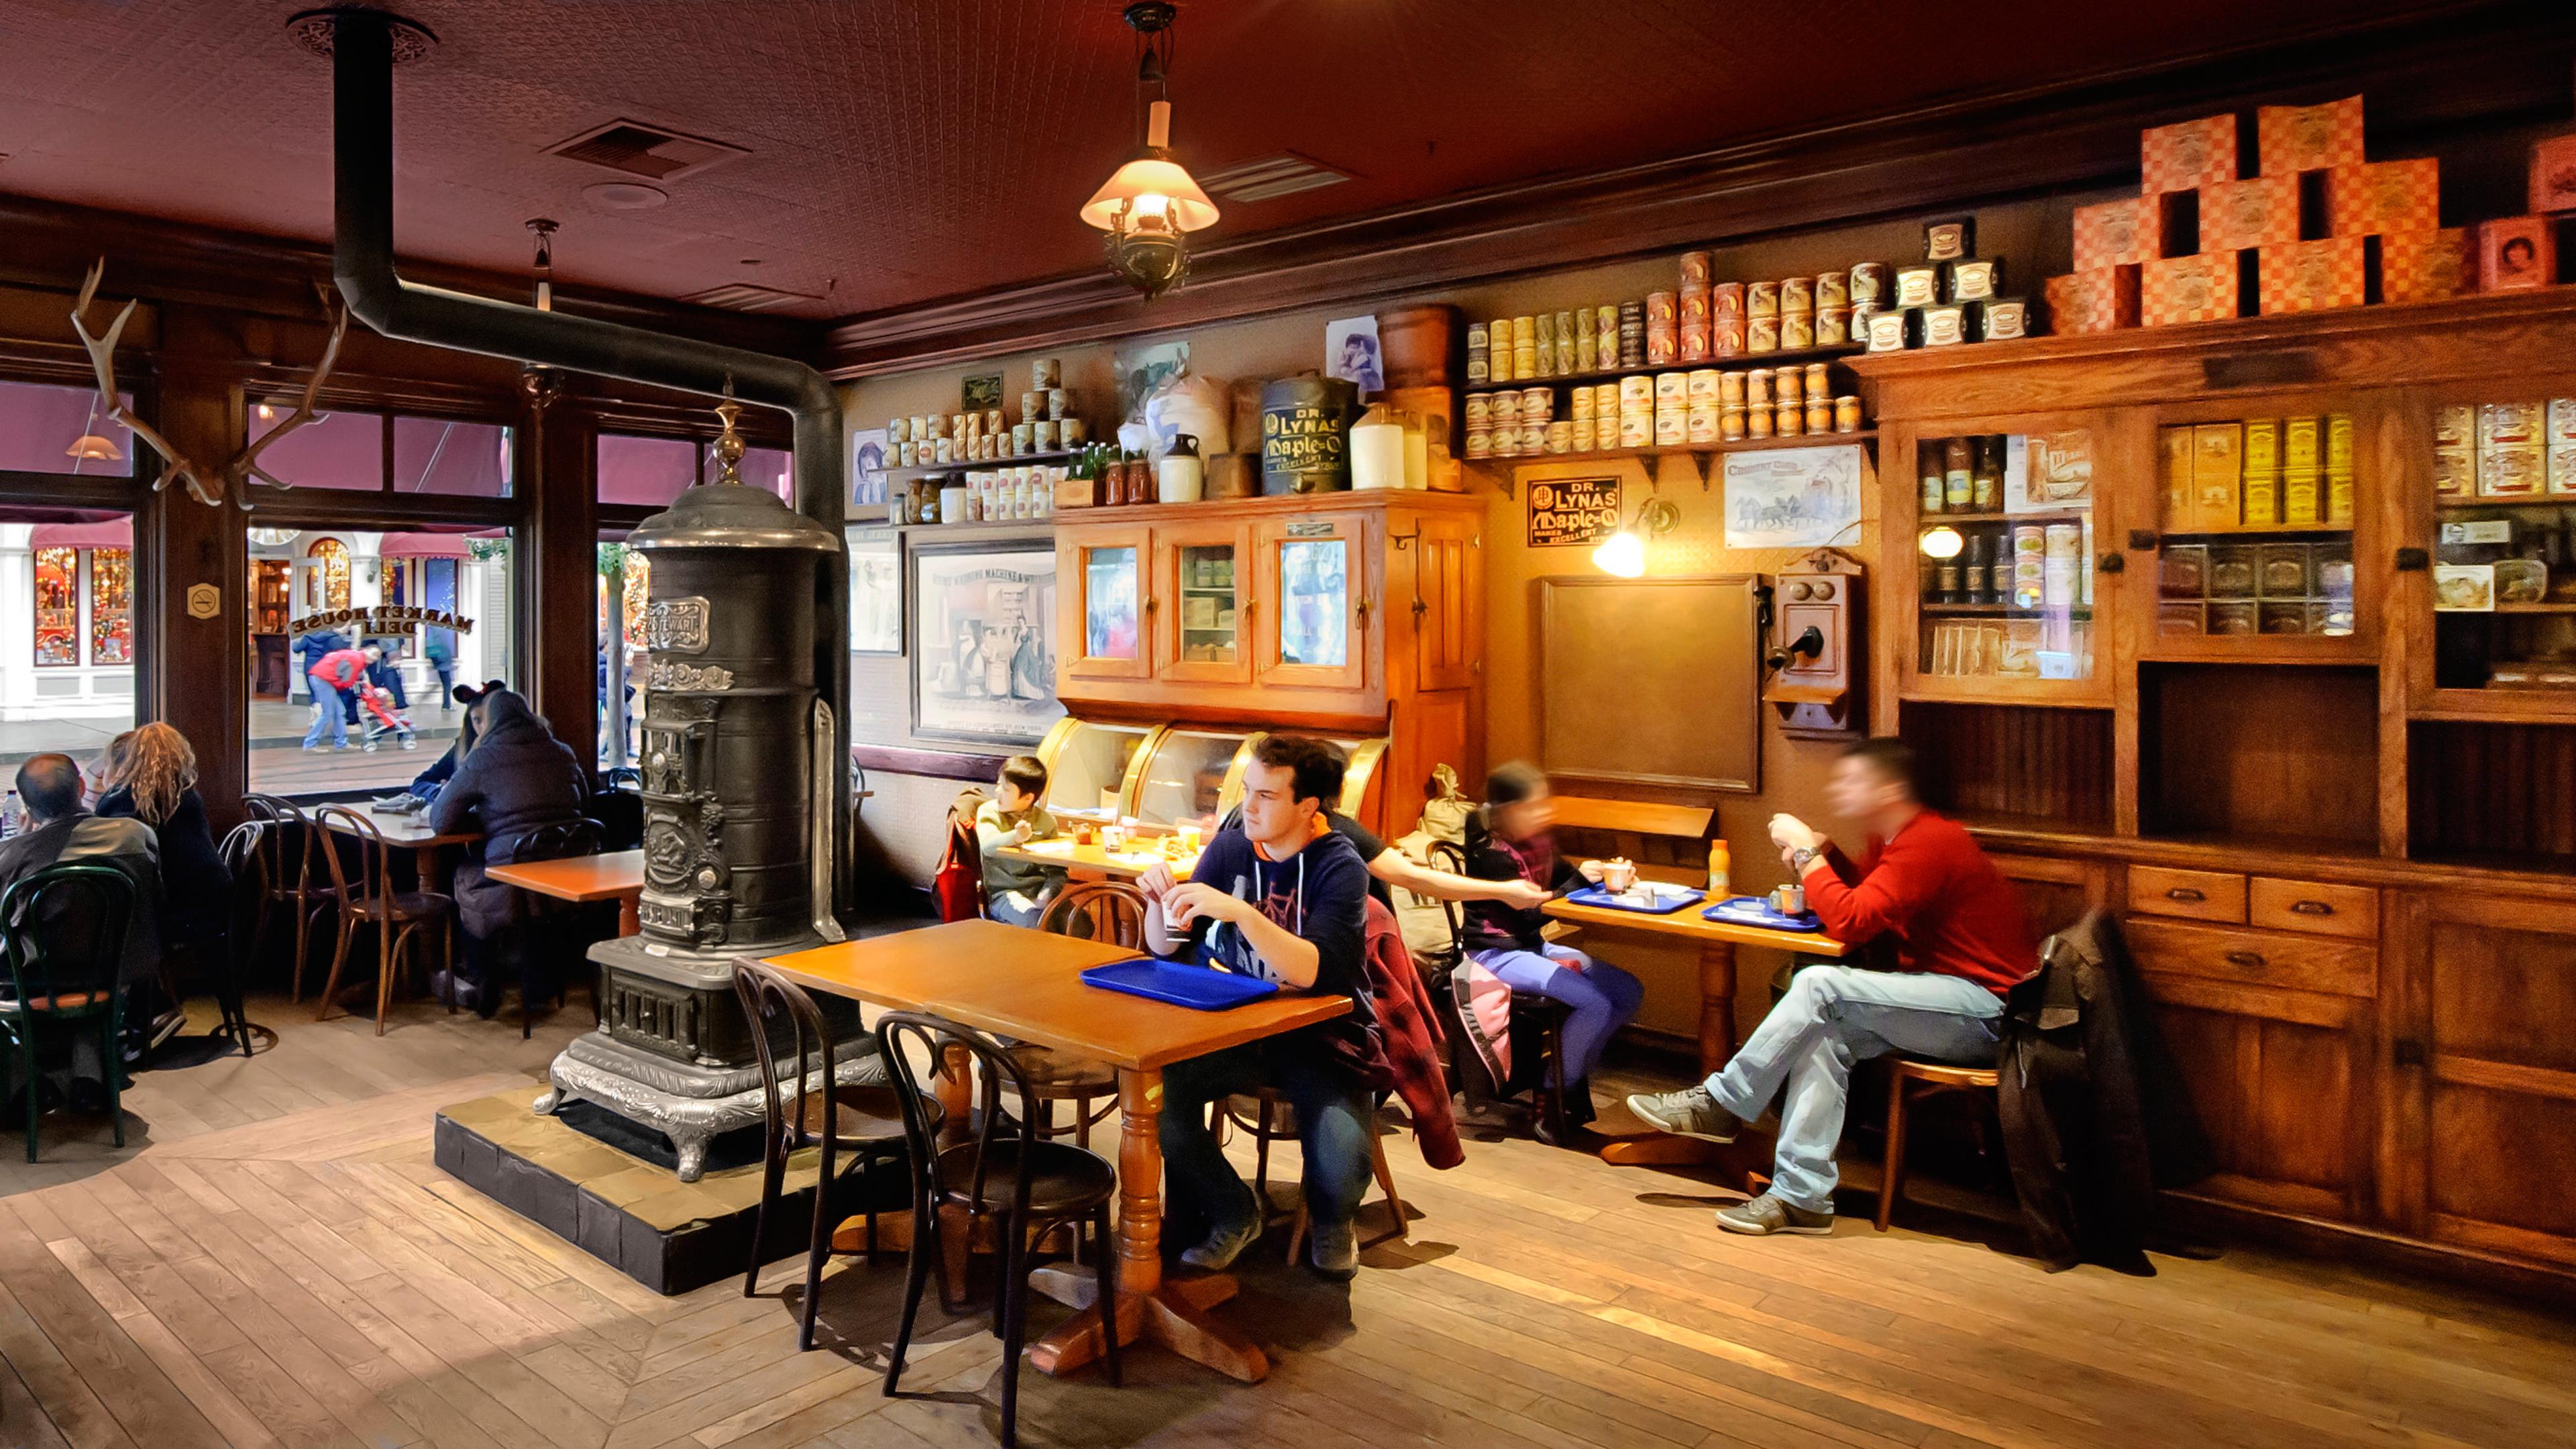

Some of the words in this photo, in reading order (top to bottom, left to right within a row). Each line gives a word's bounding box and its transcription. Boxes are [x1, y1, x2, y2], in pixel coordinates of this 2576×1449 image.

[1571, 482, 1599, 492] DR.
[1550, 528, 1597, 543] EXCELLENT
[985, 568, 1016, 582] MACHINE
